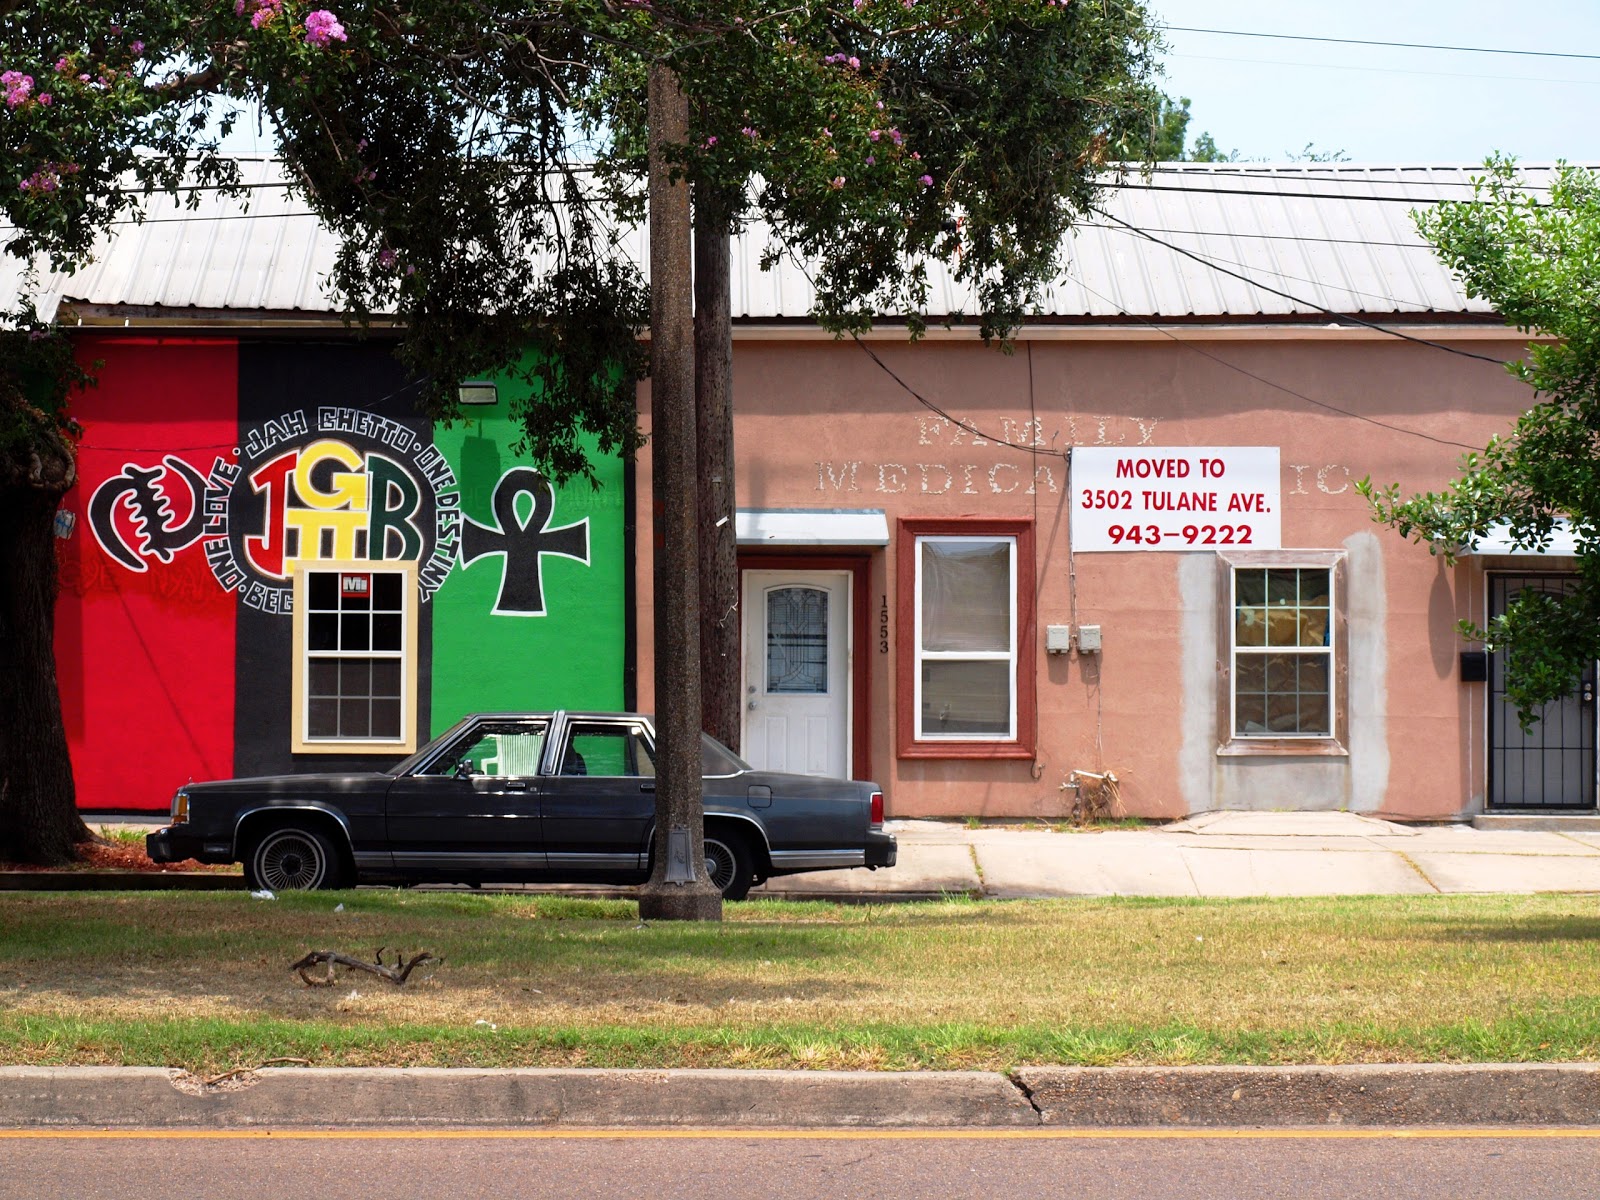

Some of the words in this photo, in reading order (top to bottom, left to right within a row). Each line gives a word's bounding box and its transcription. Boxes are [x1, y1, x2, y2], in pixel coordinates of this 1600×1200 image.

[245, 409, 308, 460] JAH
[318, 406, 416, 454] GHETTO
[413, 443, 457, 494] ONE
[815, 461, 1059, 495] MEDICA
[1116, 459, 1190, 478] MOVED
[1199, 459, 1225, 478] TO
[203, 455, 242, 536] LOVE
[1082, 489, 1132, 509] 3502
[1142, 491, 1217, 511] TULANE
[1227, 493, 1271, 513] AVE.
[417, 491, 461, 604] DESTINY
[1108, 525, 1252, 544] 943-9222
[203, 536, 248, 593] ONE
[880, 595, 889, 653] 1553
